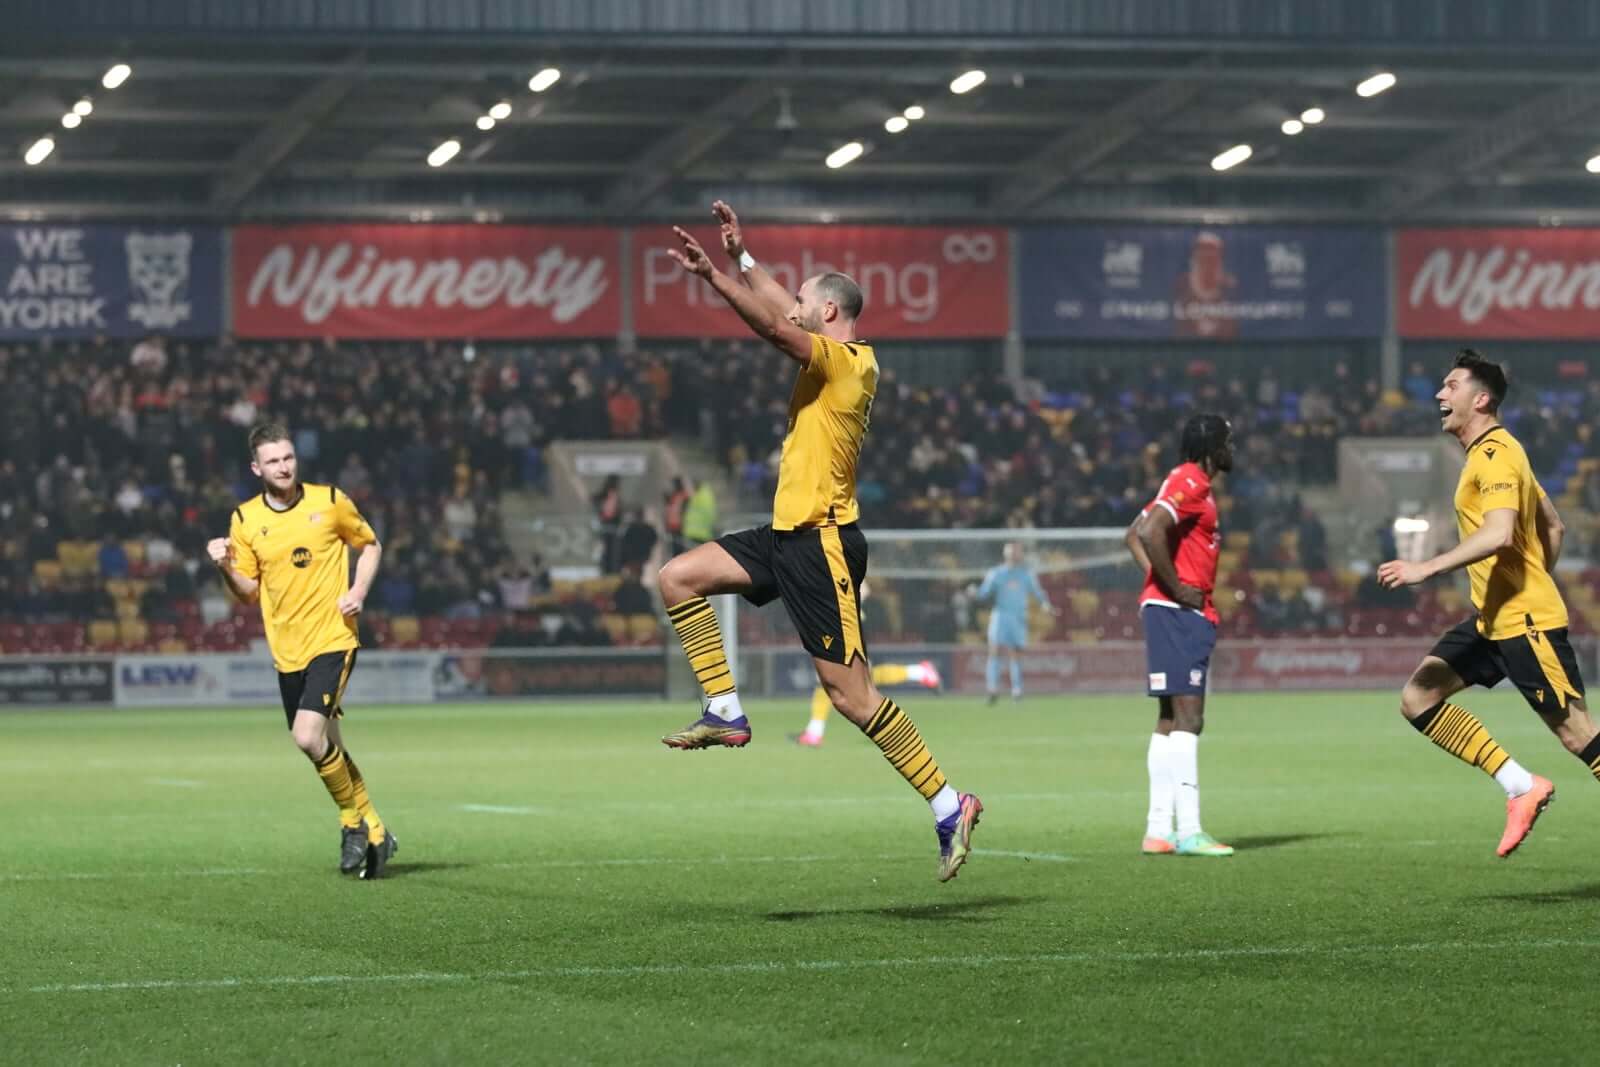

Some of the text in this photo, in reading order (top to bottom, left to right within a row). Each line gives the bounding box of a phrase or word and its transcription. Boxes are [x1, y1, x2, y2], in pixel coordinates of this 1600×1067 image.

[15, 229, 84, 260] WE
[9, 264, 92, 295] ARE
[247, 243, 607, 323] Nfinnerty
[0, 299, 105, 328] YORK
[121, 663, 200, 686] LEW
